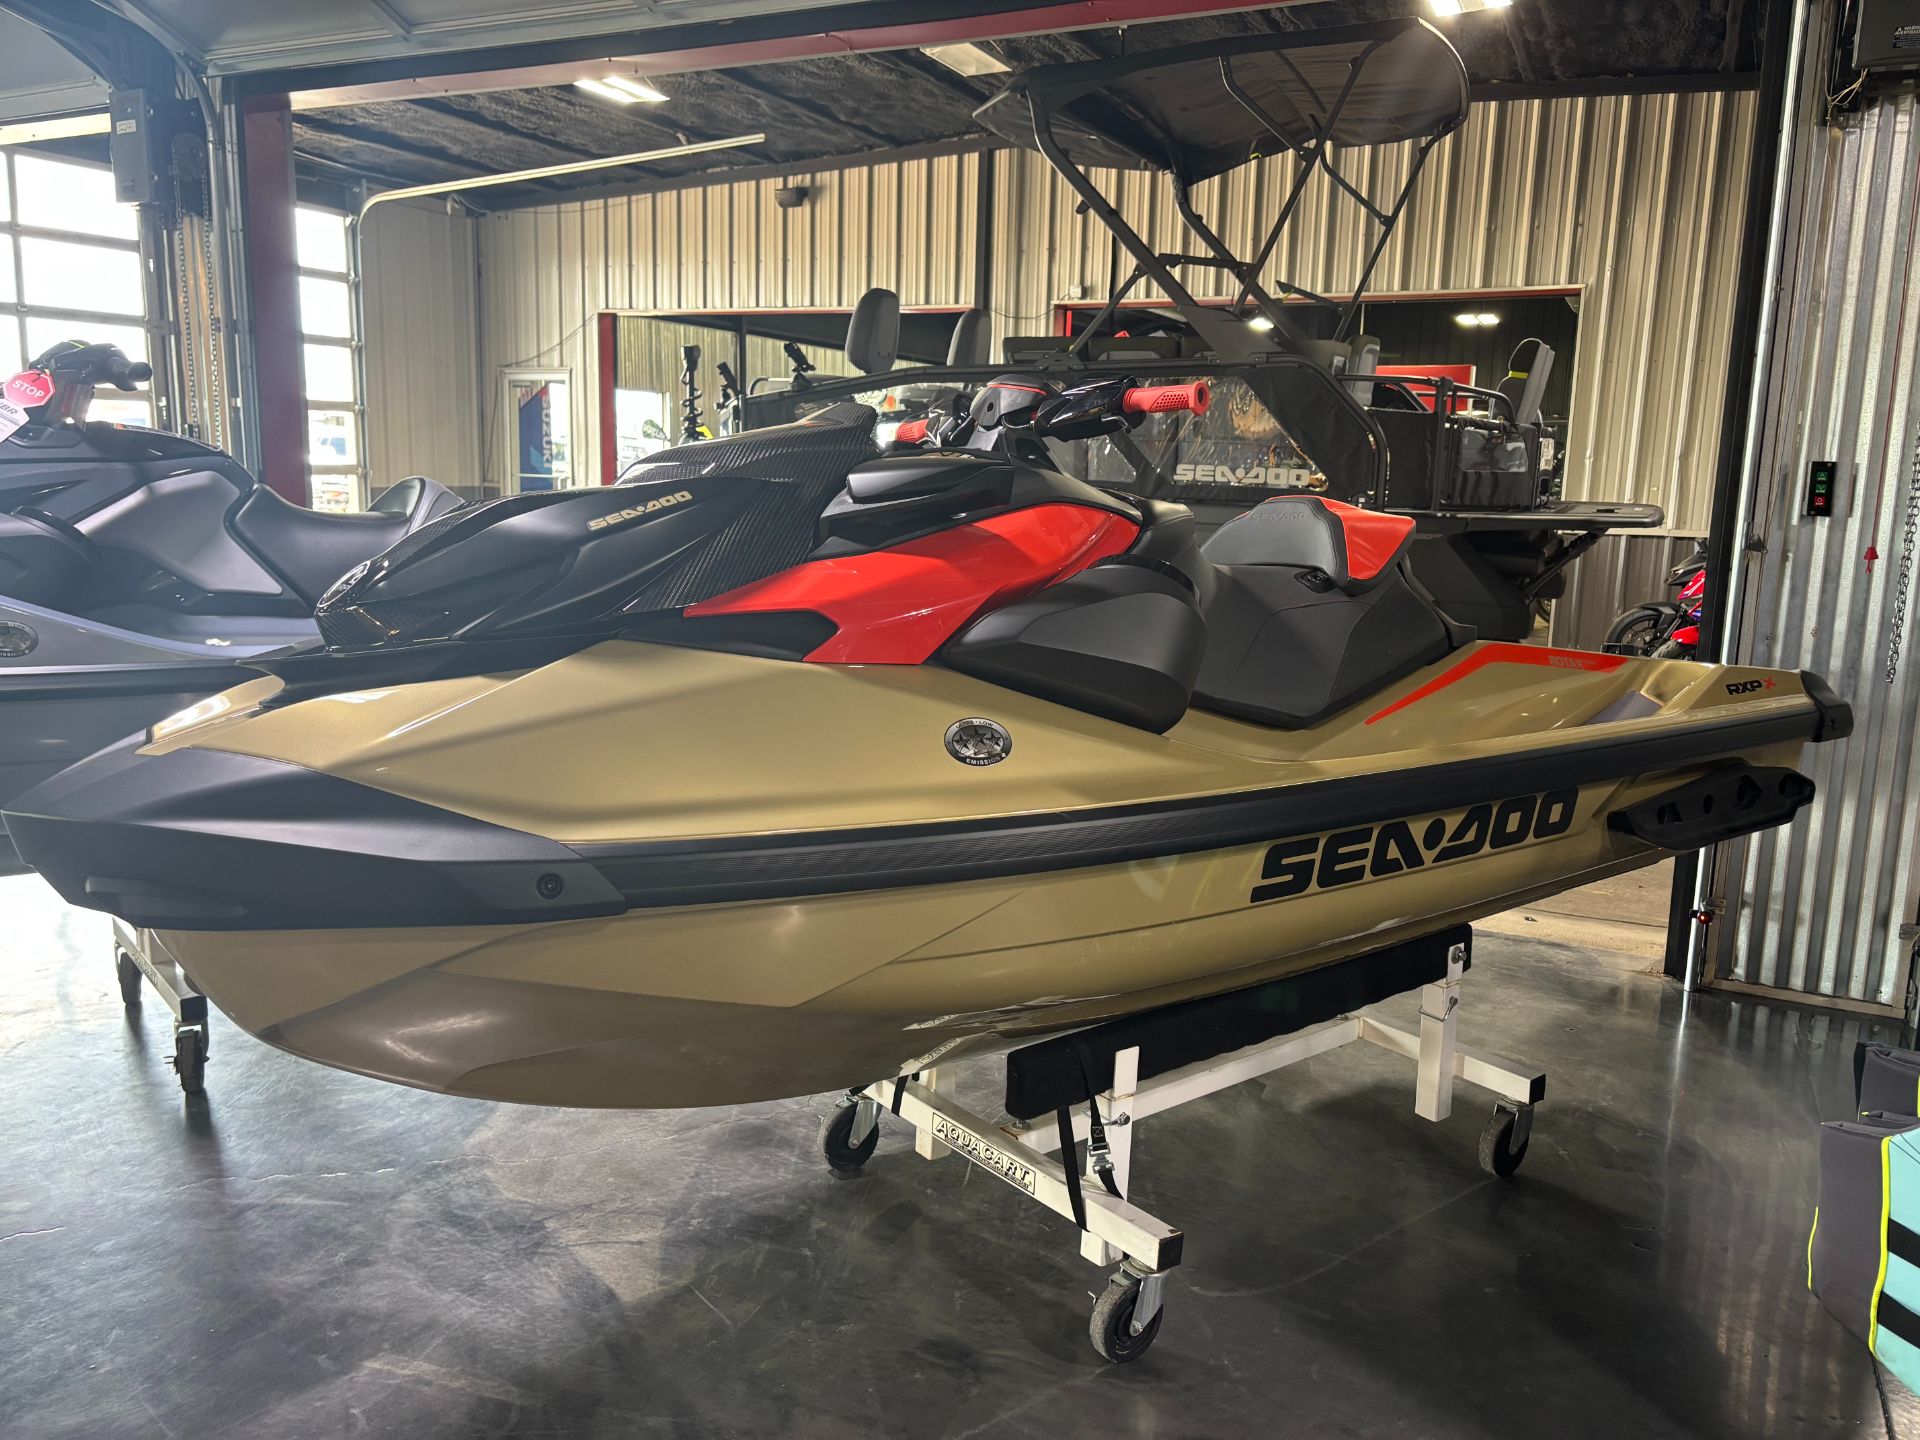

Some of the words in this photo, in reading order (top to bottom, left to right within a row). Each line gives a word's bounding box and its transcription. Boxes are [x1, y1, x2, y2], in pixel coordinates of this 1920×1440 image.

[12, 380, 45, 397] STOP
[541, 394, 552, 468] SUZUKI
[955, 719, 975, 729] ULTRA
[979, 720, 994, 728] LOW
[966, 756, 1001, 766] EMISSION
[935, 1119, 1030, 1182] AQUACART
